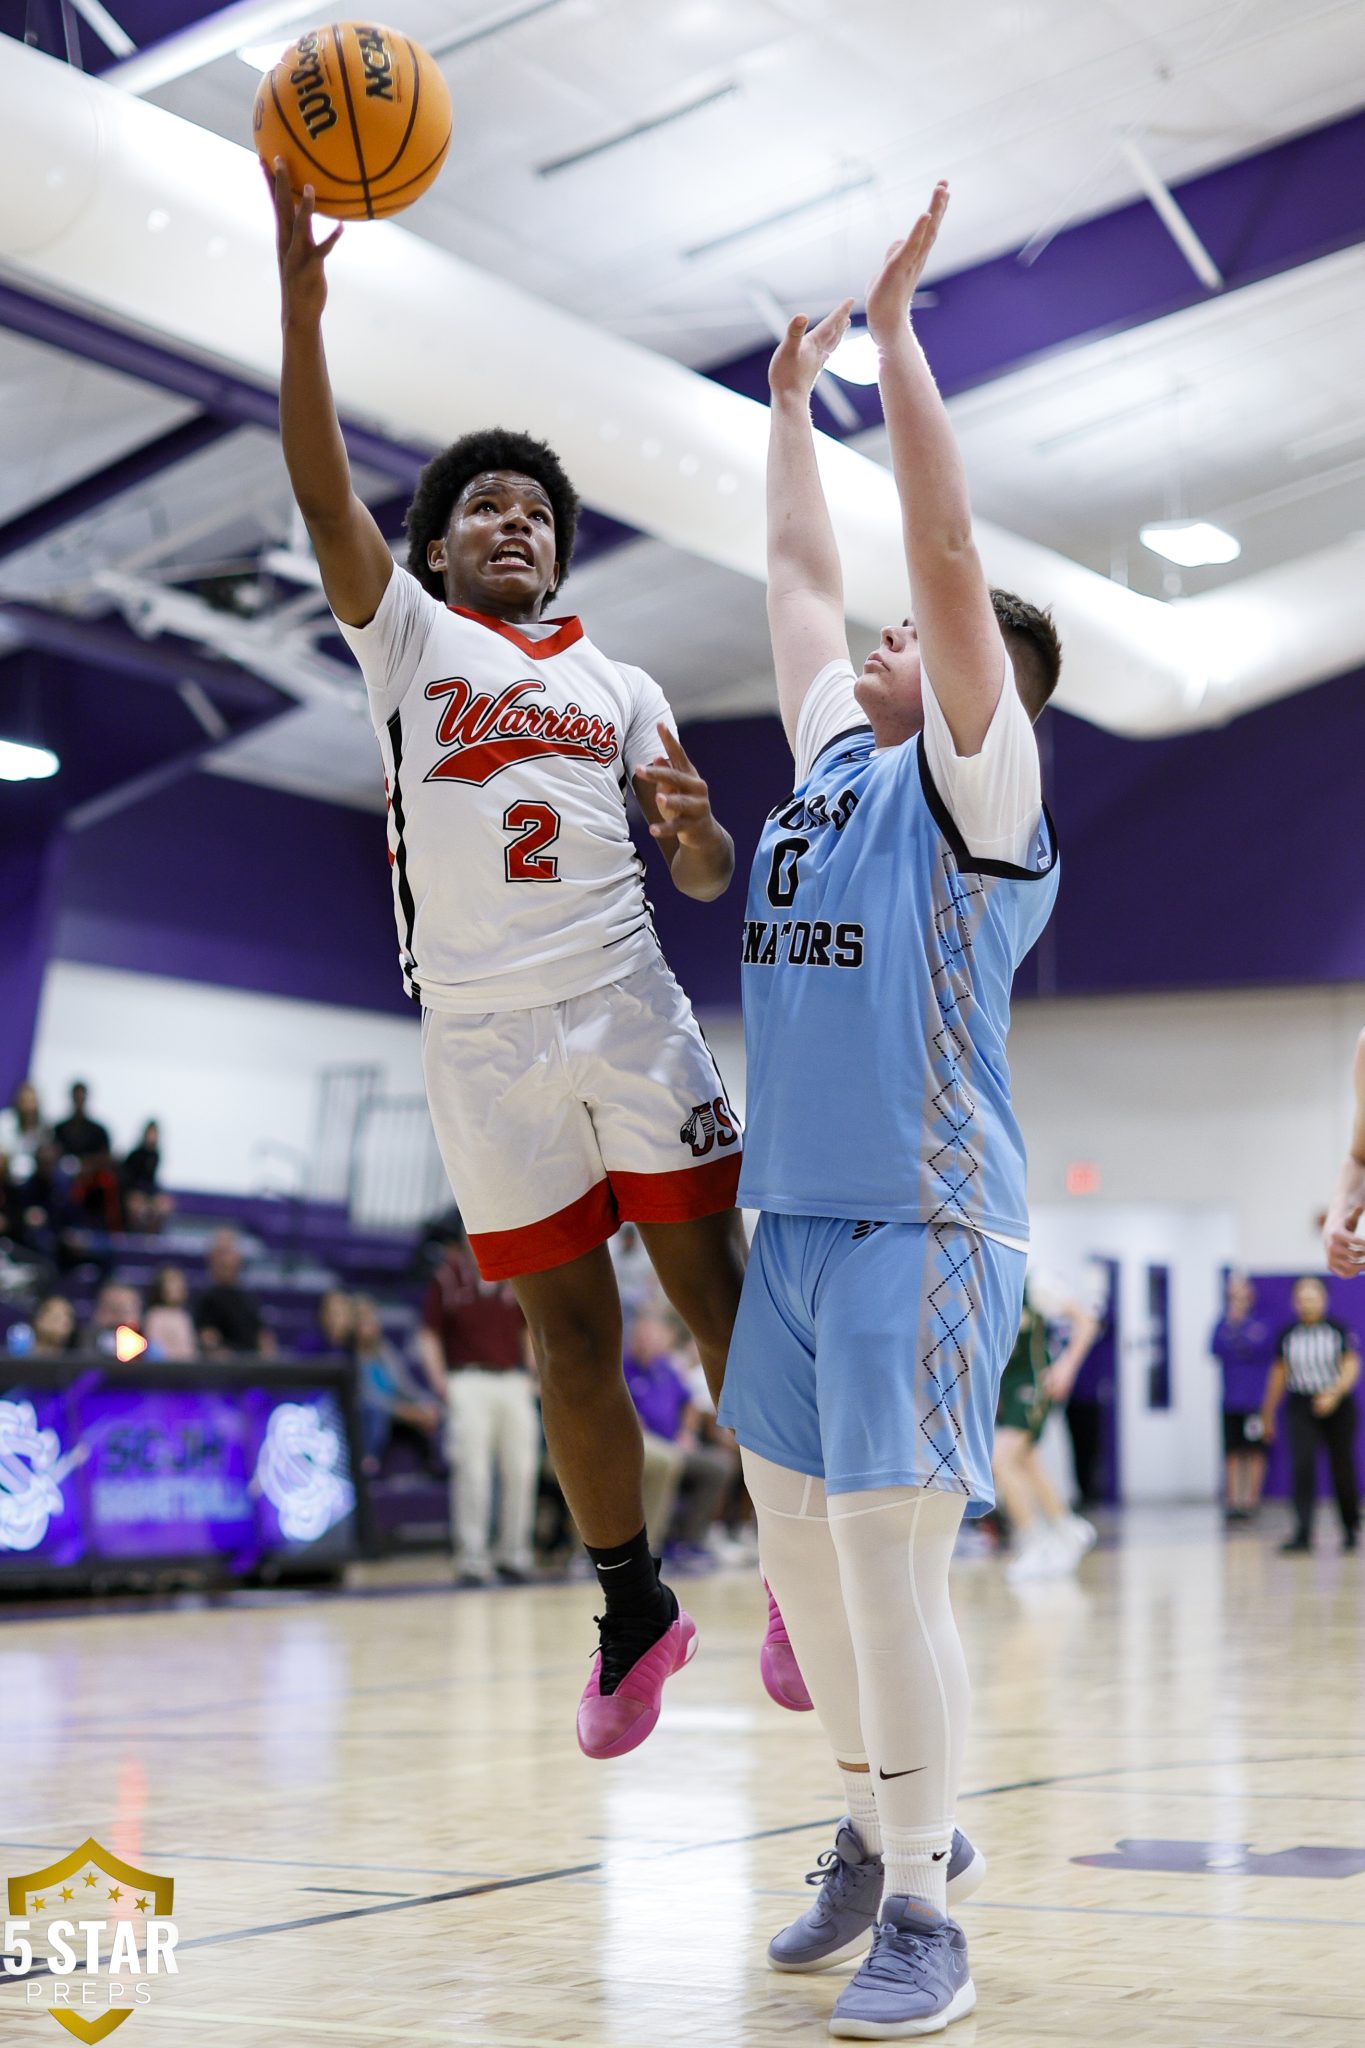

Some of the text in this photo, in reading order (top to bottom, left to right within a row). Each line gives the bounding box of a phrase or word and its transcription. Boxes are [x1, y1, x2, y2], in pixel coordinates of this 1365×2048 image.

[424, 676, 619, 764] Warriors
[503, 799, 562, 883] 2
[766, 836, 811, 909] 0
